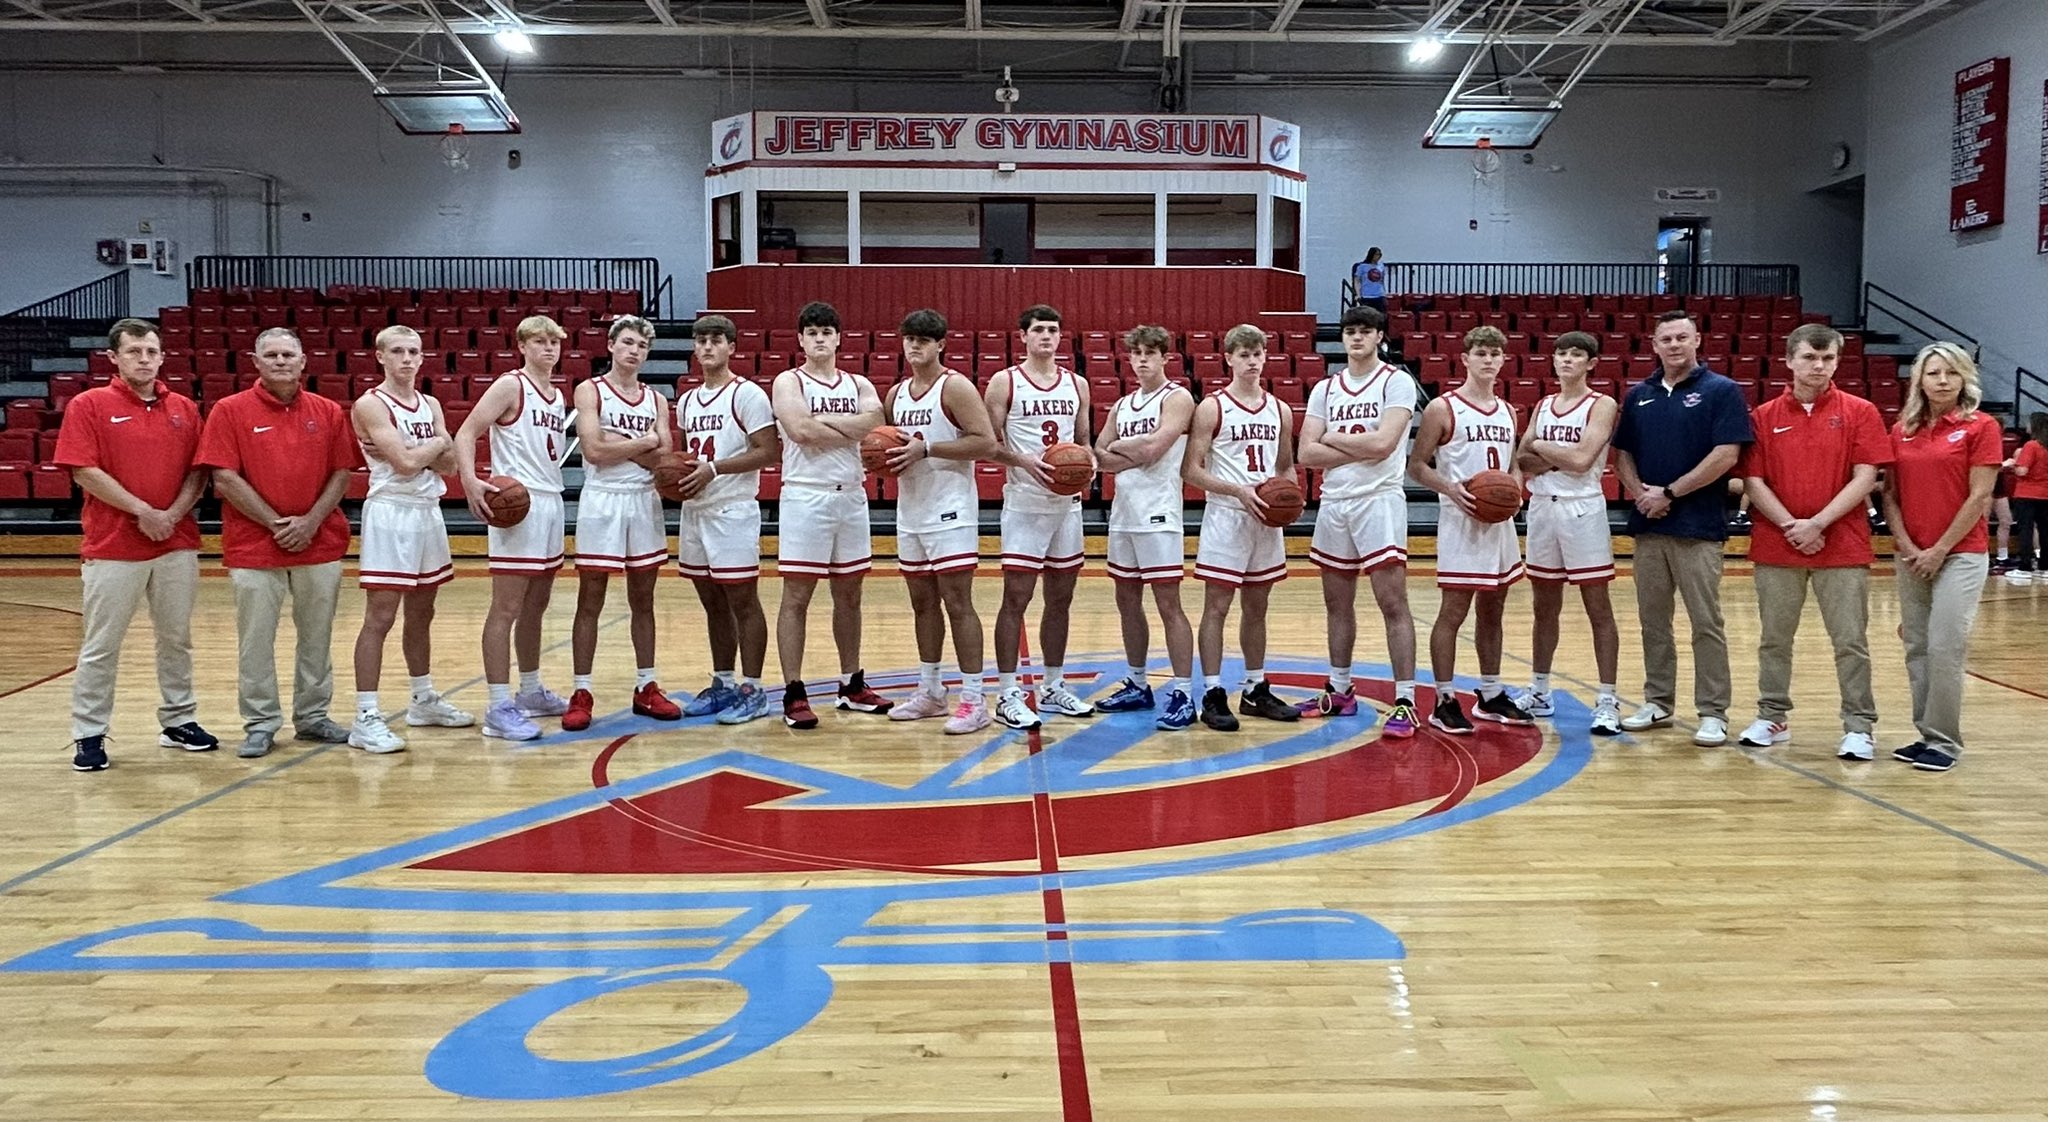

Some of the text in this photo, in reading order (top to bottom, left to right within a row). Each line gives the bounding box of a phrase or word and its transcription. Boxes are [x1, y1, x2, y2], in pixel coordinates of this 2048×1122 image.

[765, 116, 1250, 159] JEFFREY GYMNASIUM
[1021, 399, 1075, 417] LAKERS
[1328, 401, 1379, 422] LAKERS
[609, 412, 656, 432] LAKER
[1230, 423, 1277, 441] LAKERS
[1041, 420, 1060, 447] 3
[1465, 424, 1511, 444] LAKERS
[1245, 444, 1267, 473] 11
